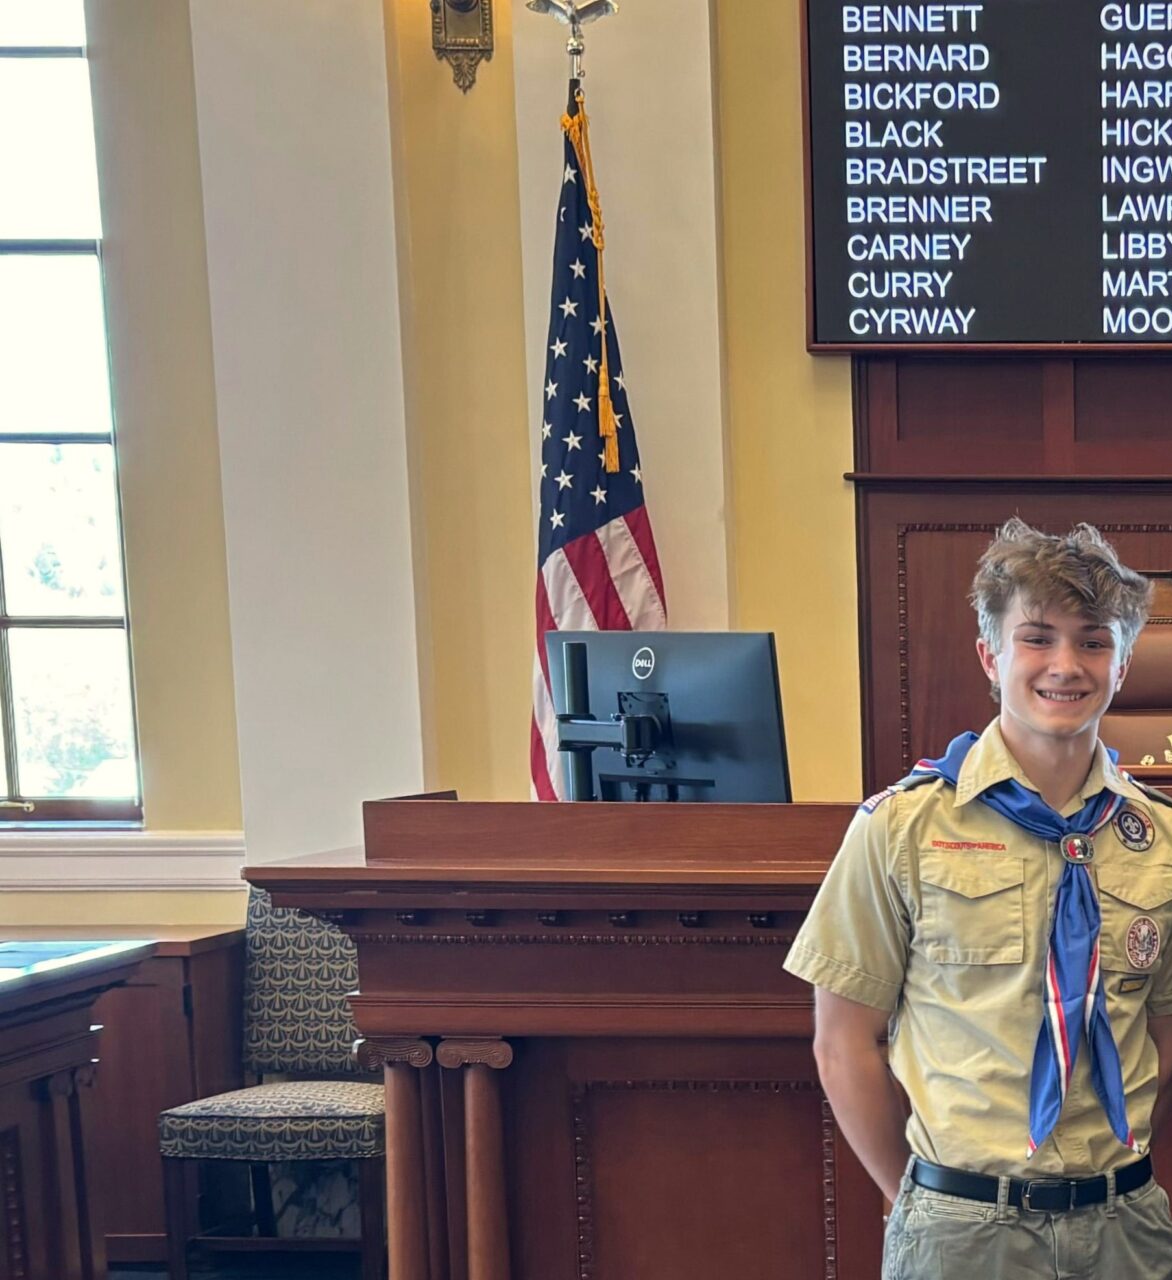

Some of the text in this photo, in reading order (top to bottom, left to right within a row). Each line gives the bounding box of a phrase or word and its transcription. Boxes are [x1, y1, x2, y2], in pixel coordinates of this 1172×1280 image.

[843, 5, 983, 32] BENNETT
[844, 44, 989, 71] BERNARD
[845, 82, 999, 110] BICKFORD
[846, 120, 943, 147] BLACK
[846, 157, 1047, 184] BRADSTREET
[847, 196, 992, 223] BRENNER
[848, 234, 971, 261] CARNEY
[848, 271, 953, 298] CURRY
[849, 308, 975, 334] CYRWAY
[635, 658, 652, 667] DELL
